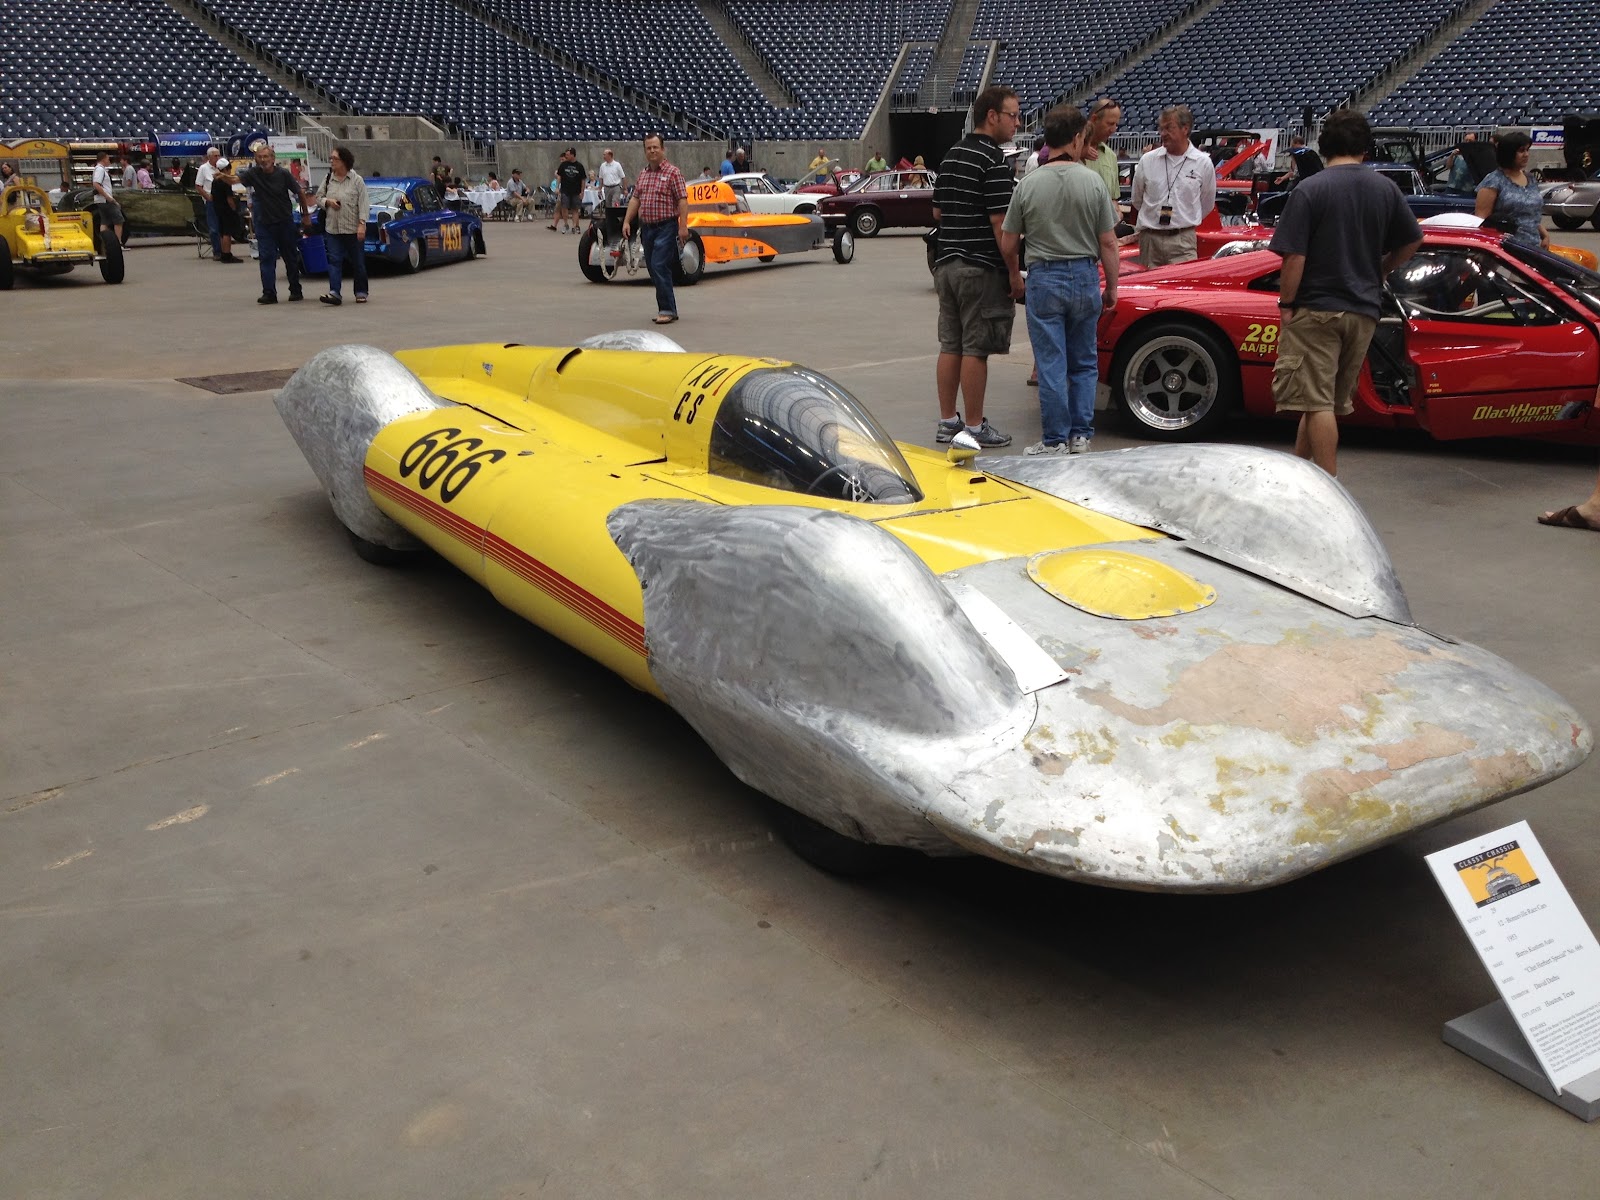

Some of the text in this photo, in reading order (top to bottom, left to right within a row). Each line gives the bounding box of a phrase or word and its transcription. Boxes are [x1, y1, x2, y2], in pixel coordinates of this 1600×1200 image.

[1244, 323, 1280, 343] 28
[1240, 342, 1279, 354] AA/BF
[1472, 402, 1562, 421] BlackHorse
[399, 428, 506, 503] 666
[1457, 842, 1514, 868] CLASSY CHASSIS
